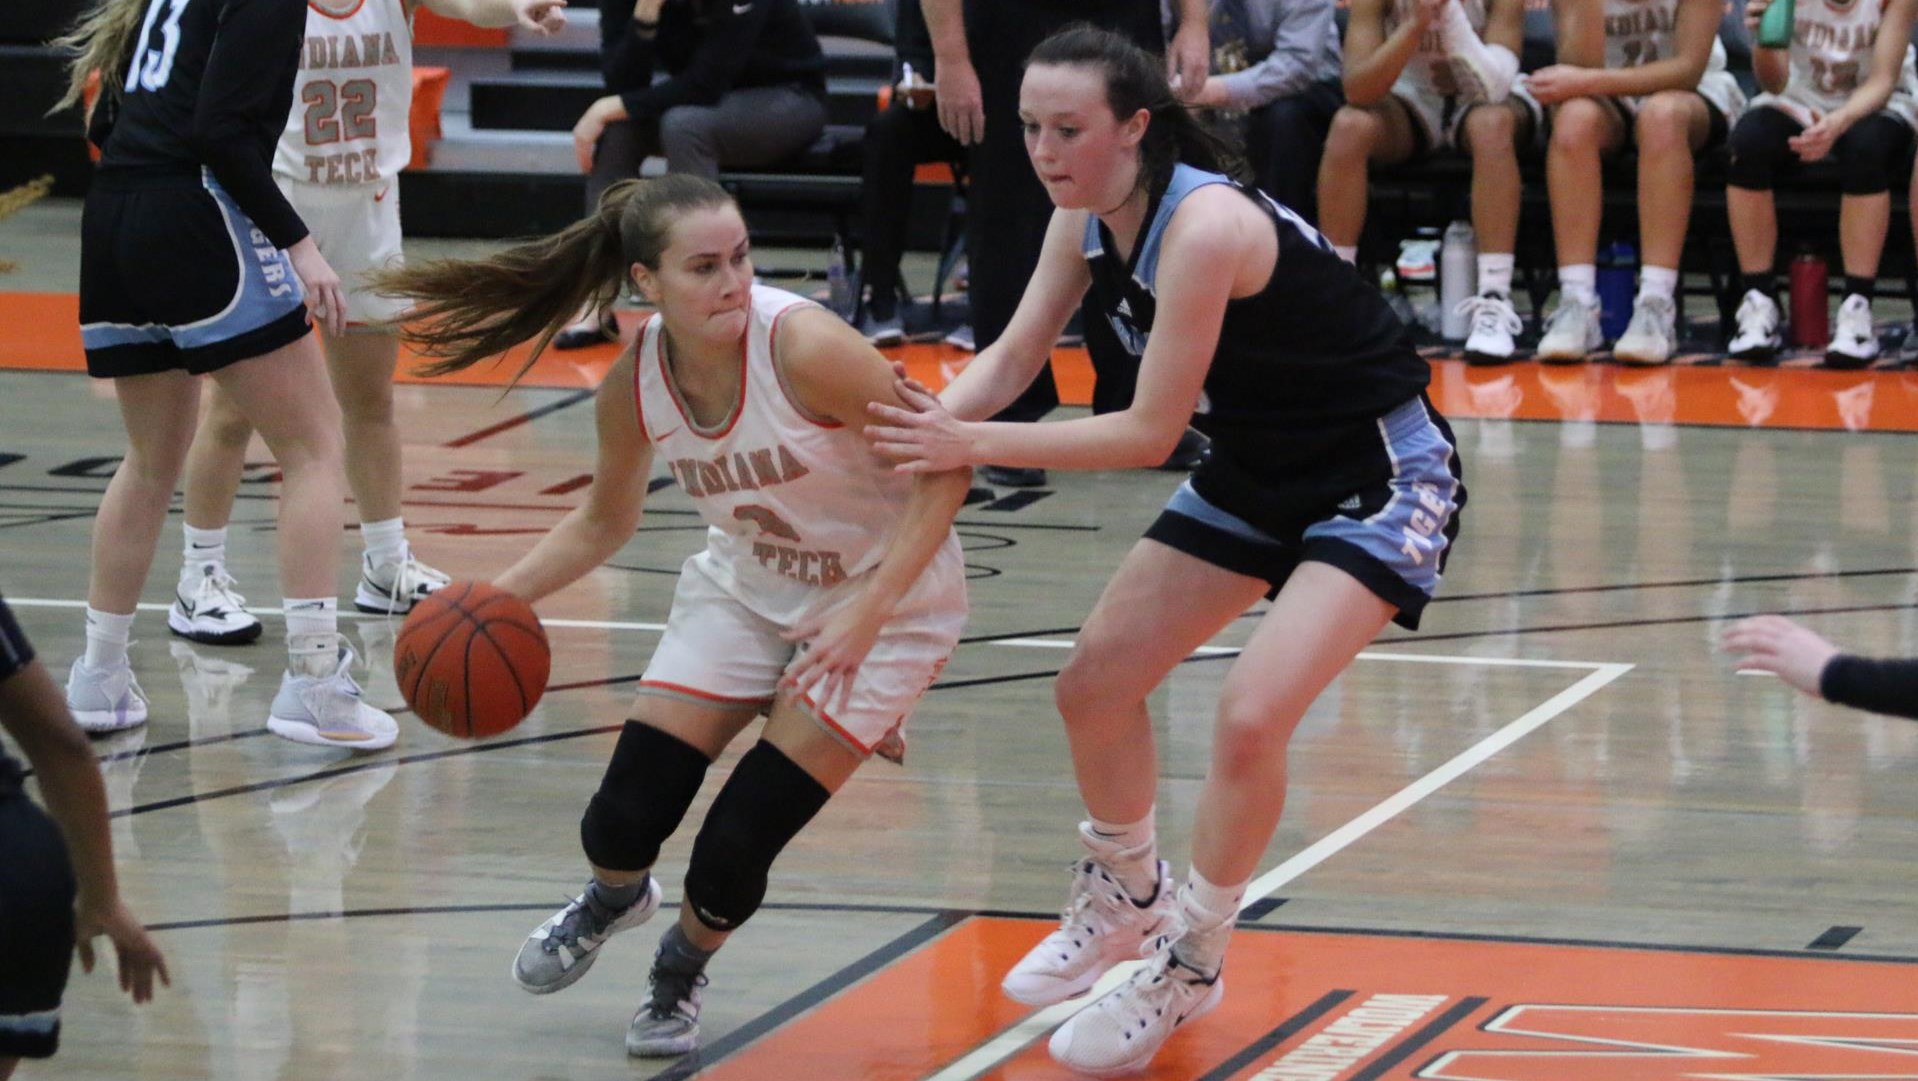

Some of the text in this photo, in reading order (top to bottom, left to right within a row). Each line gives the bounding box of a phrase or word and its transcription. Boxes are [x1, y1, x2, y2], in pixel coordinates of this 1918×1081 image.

[299, 32, 400, 70] DIANA
[302, 78, 377, 145] 22
[304, 149, 381, 185] TECH
[248, 218, 292, 297] GERS
[752, 541, 848, 588] TECH
